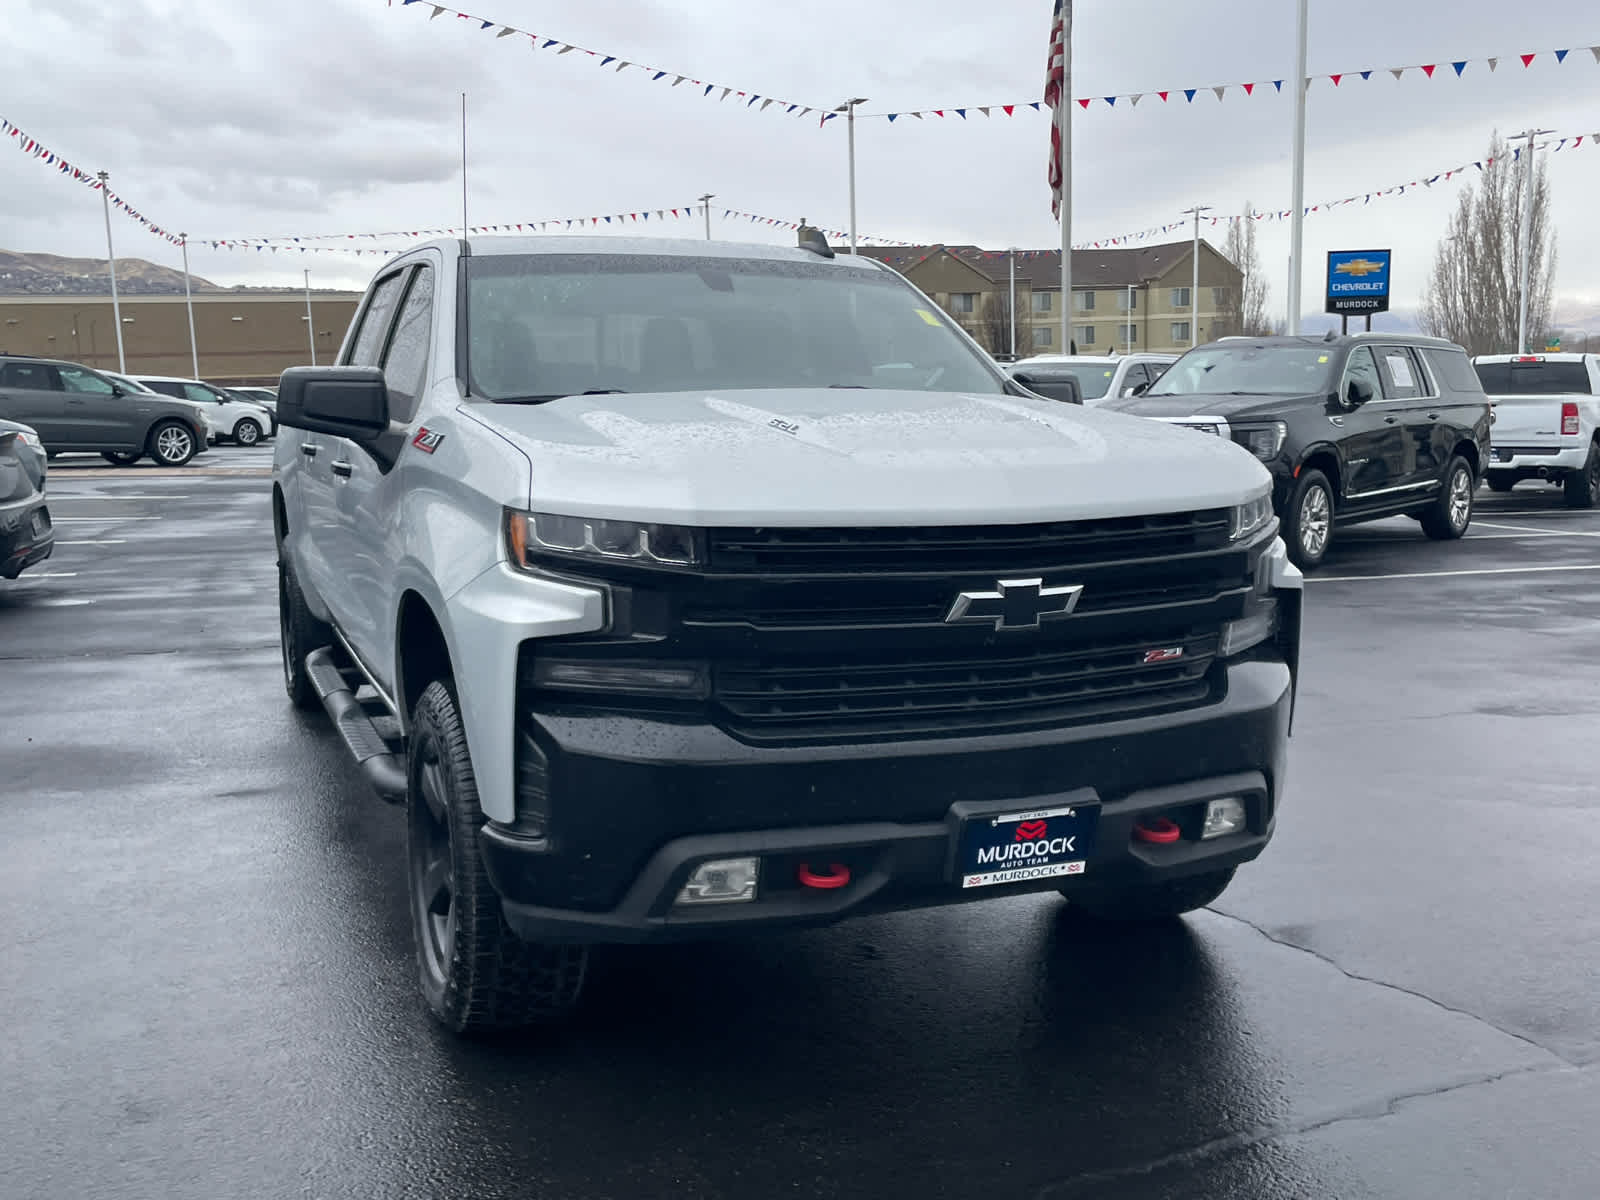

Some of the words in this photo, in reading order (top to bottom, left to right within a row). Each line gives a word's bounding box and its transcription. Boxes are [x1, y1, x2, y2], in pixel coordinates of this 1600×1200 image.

[1332, 282, 1384, 291] CHEVROLET
[1336, 300, 1379, 309] MURDOCK
[977, 835, 1076, 864] MURDOCK
[1000, 860, 1023, 869] AUTO
[1026, 856, 1049, 866] TEAM
[992, 865, 1058, 883] MURDOCK
